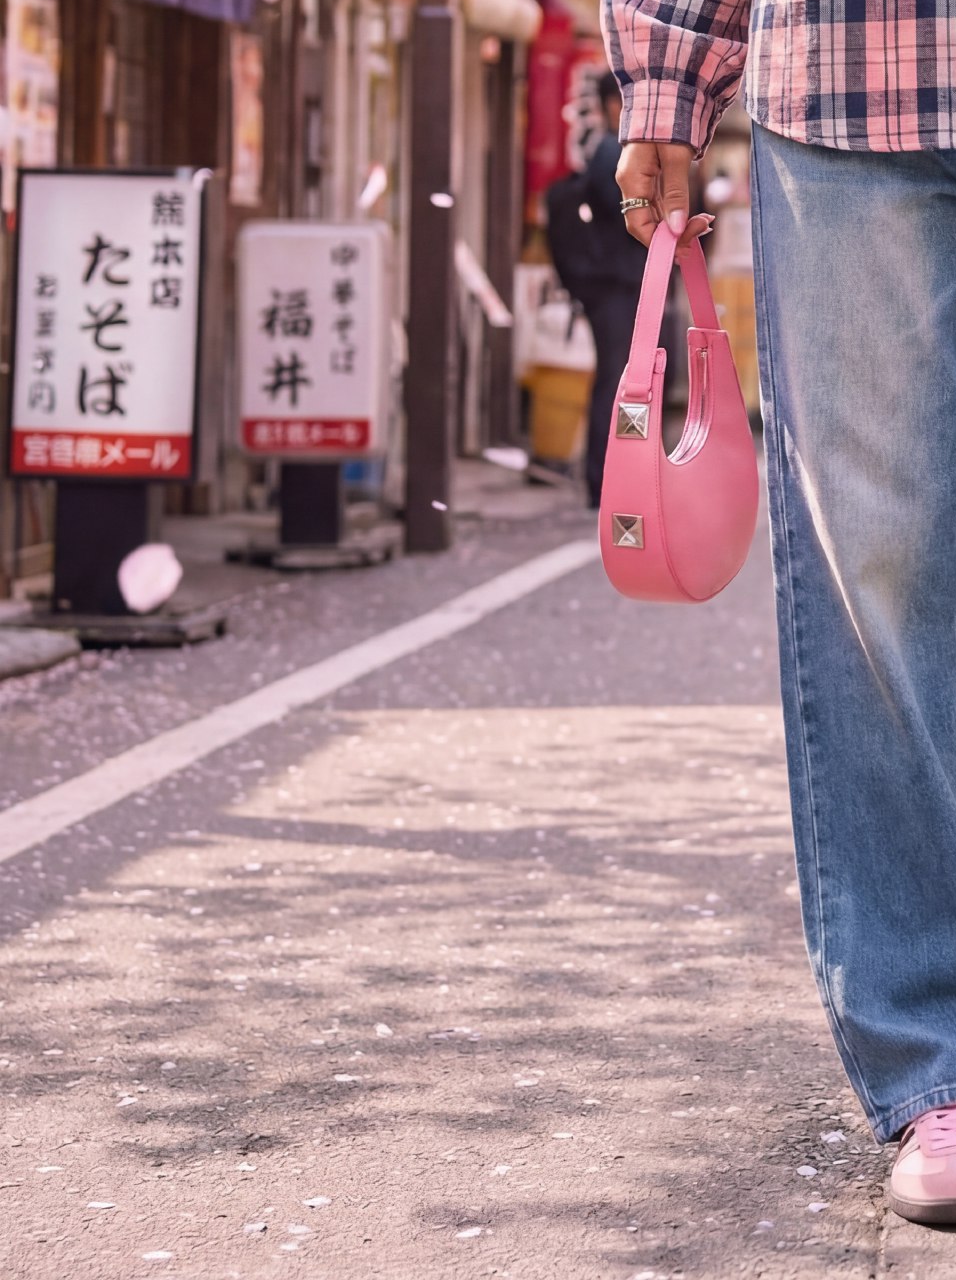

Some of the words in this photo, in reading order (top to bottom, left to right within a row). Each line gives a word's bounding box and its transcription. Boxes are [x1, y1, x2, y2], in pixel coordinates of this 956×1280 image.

[77, 232, 133, 418] たそば
[260, 287, 314, 410] 福井
